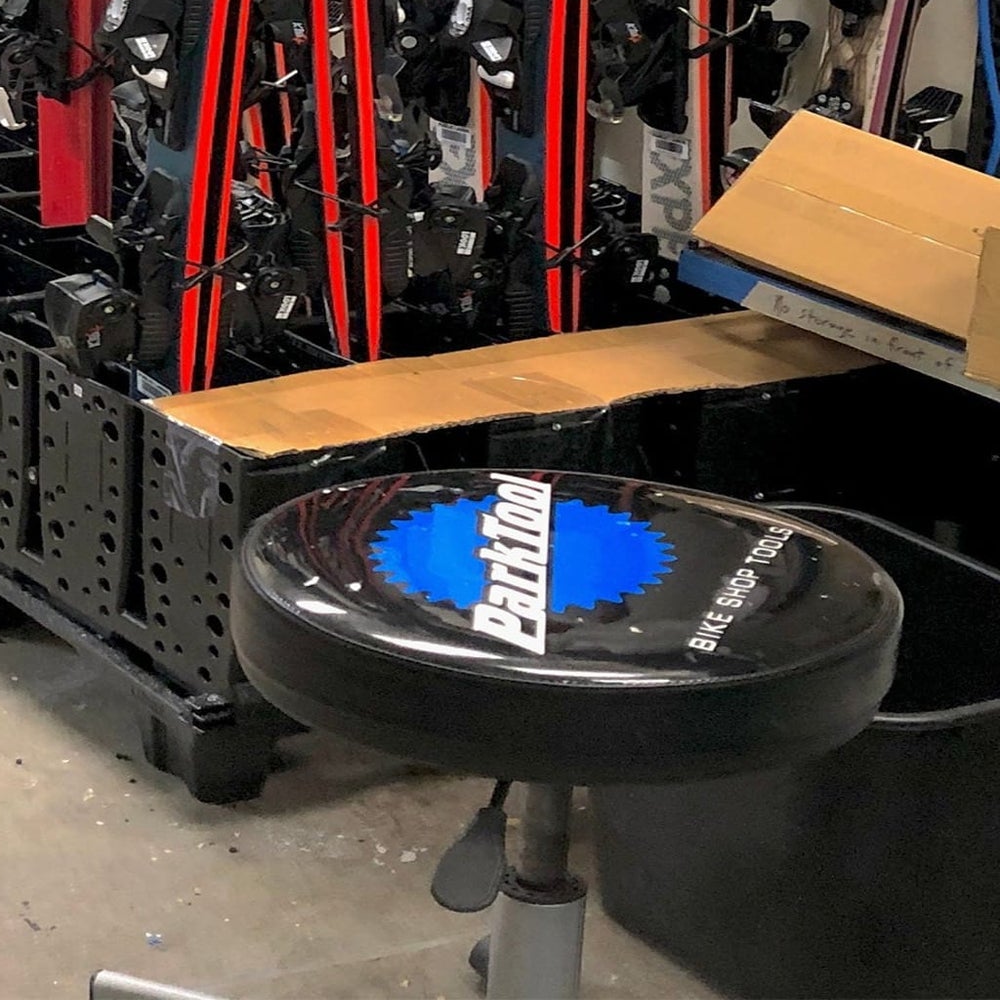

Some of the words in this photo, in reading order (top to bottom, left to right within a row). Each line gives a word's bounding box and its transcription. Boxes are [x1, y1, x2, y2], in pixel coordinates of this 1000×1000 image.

[472, 472, 552, 656] ParkTool
[688, 610, 734, 652] BIKE
[716, 568, 760, 608] SHOP
[745, 526, 794, 564] TOOLS
